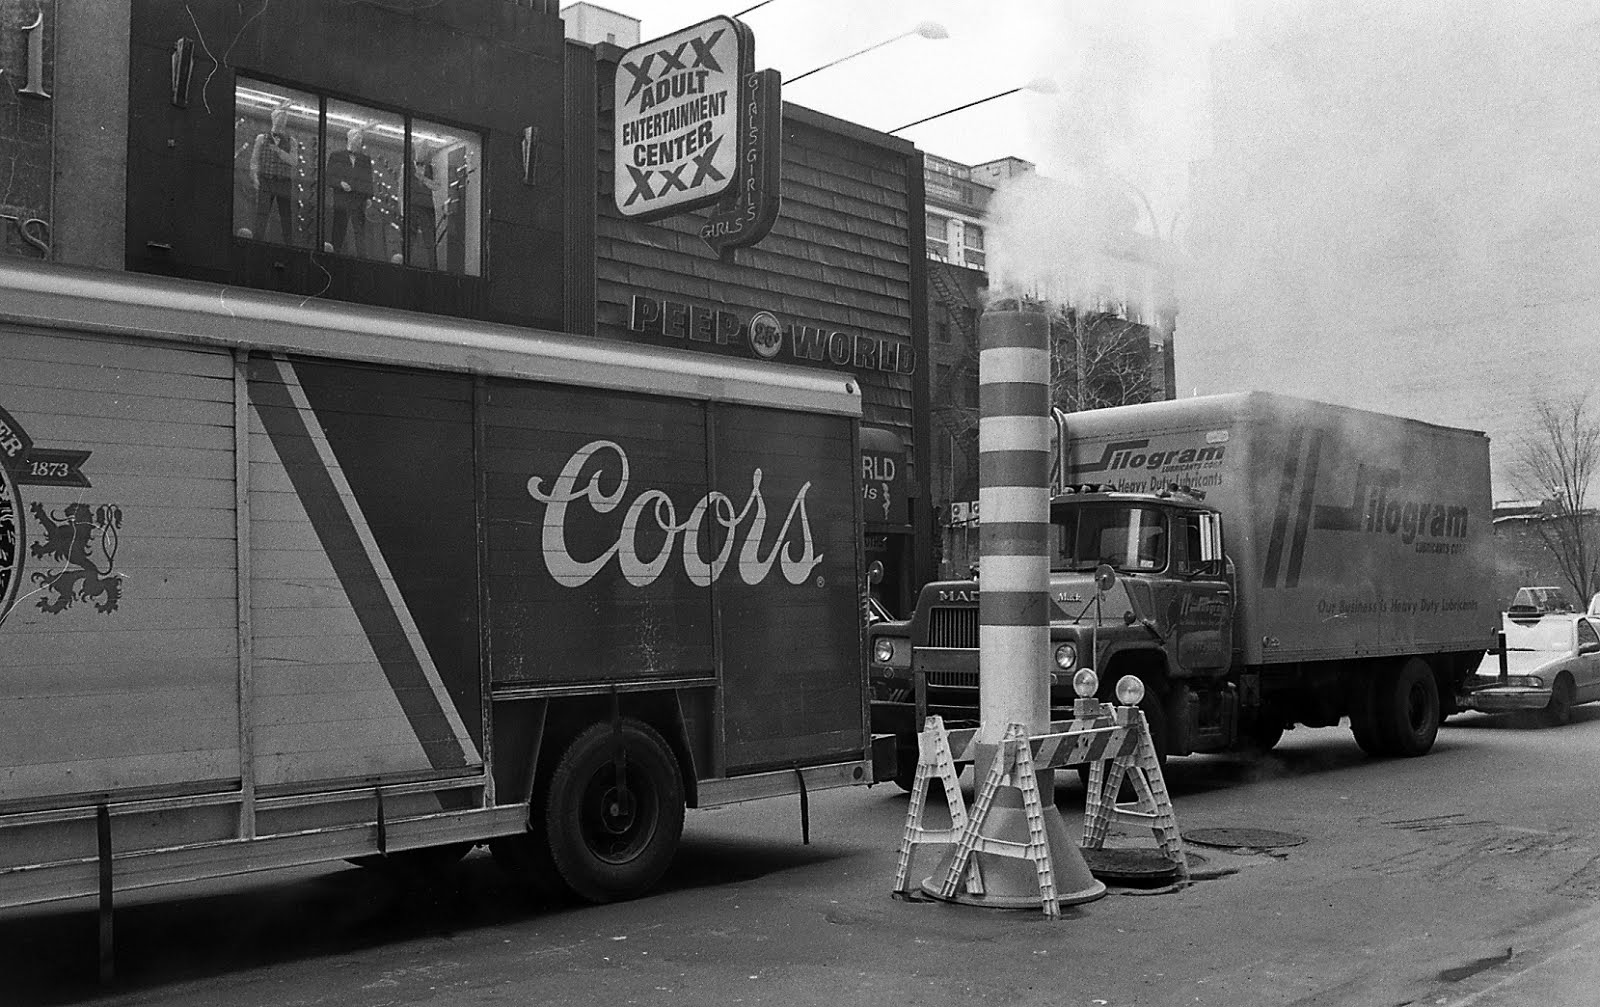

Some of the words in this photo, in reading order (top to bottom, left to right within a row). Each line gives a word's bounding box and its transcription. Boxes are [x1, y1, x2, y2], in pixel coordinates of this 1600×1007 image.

[622, 28, 726, 107] XXX
[639, 70, 709, 115] ADULT
[622, 90, 728, 146] ENTERTAINMENT
[747, 73, 759, 145] GIRLS
[623, 134, 726, 207] XXX
[633, 120, 713, 168] CENTER
[746, 148, 757, 222] GIRLS
[700, 217, 743, 238] GIRLS
[630, 294, 740, 345] PEEP
[791, 323, 917, 376] WORLD
[30, 461, 69, 477] 1873
[1118, 478, 1147, 494] Heavy
[527, 439, 824, 588] Coors
[1390, 599, 1417, 615] Heavy
